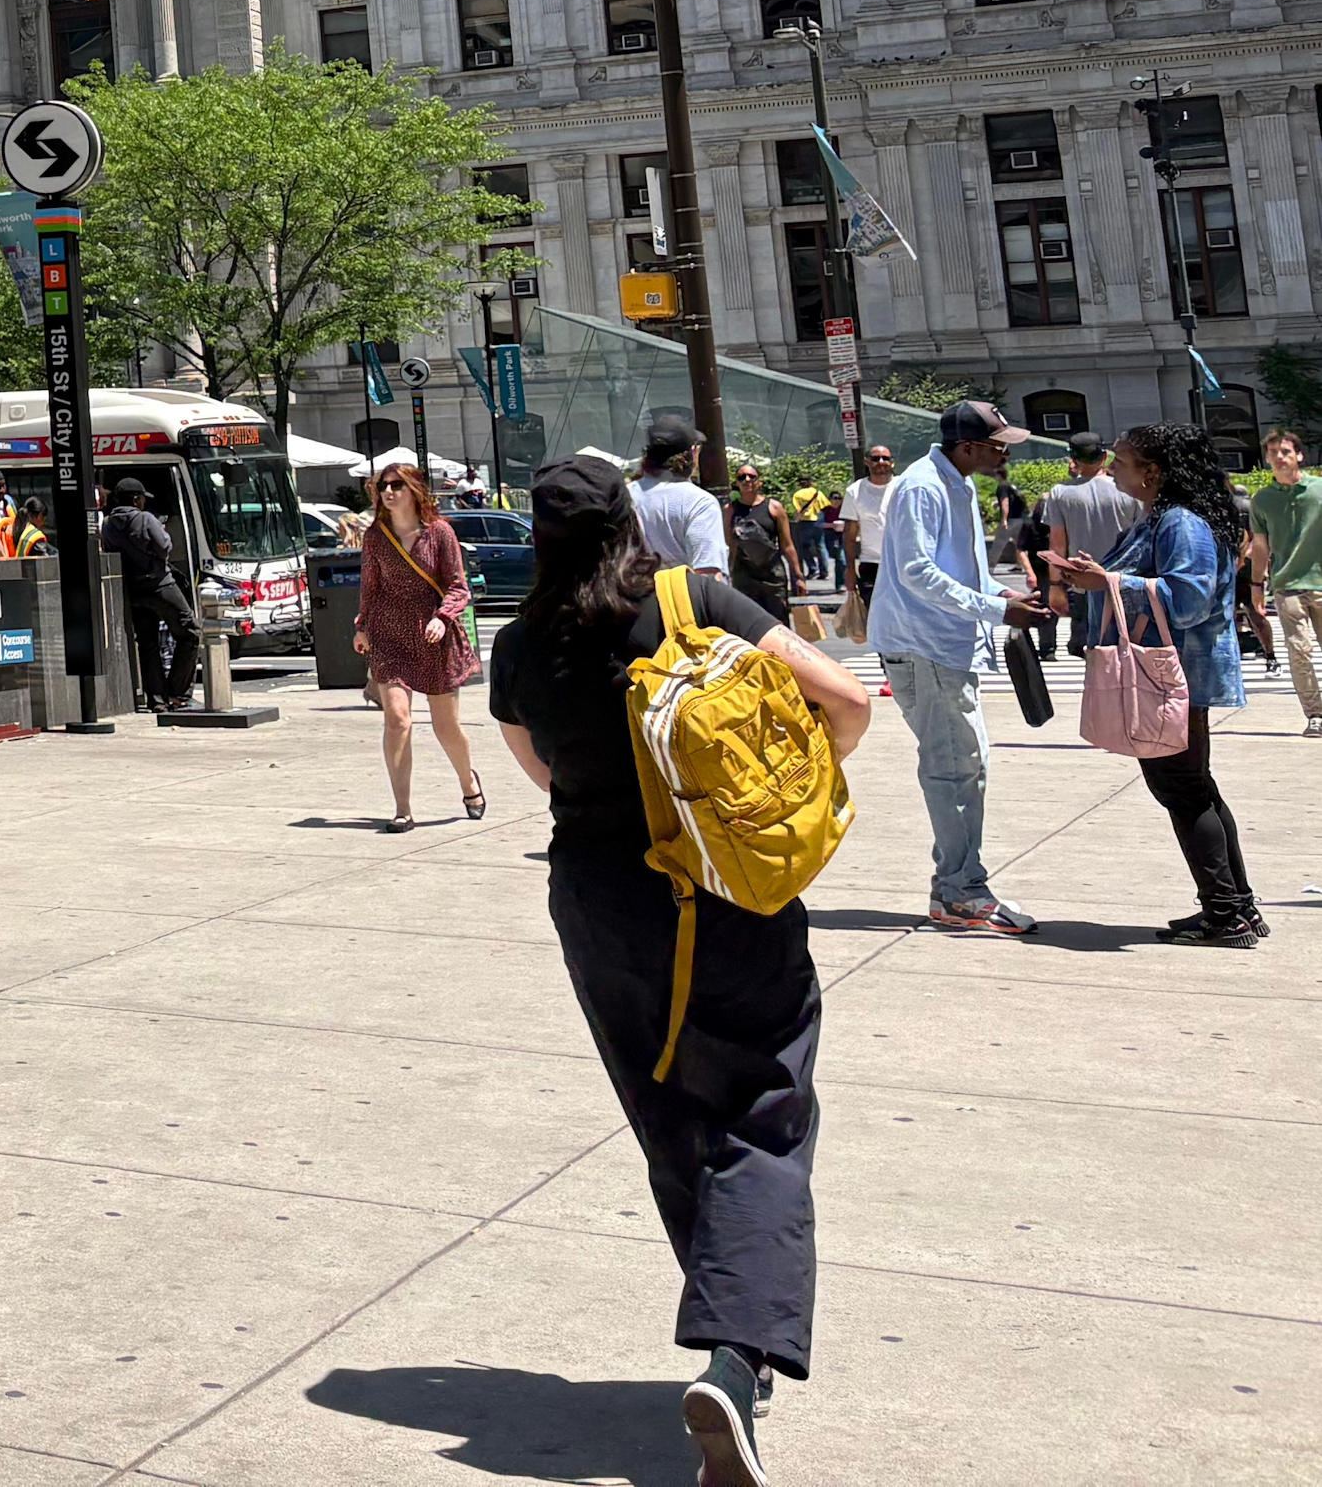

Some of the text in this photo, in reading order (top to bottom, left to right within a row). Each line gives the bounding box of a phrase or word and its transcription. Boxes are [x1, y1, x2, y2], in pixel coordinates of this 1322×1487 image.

[49, 244, 58, 256] L
[50, 270, 60, 283] B
[52, 297, 62, 310] T
[505, 350, 518, 410] Dilworth Park
[51, 325, 78, 491] 15th St / City Hall
[270, 581, 295, 598] SEPTA
[2, 634, 32, 645] Concourse
[3, 648, 24, 660] Access
